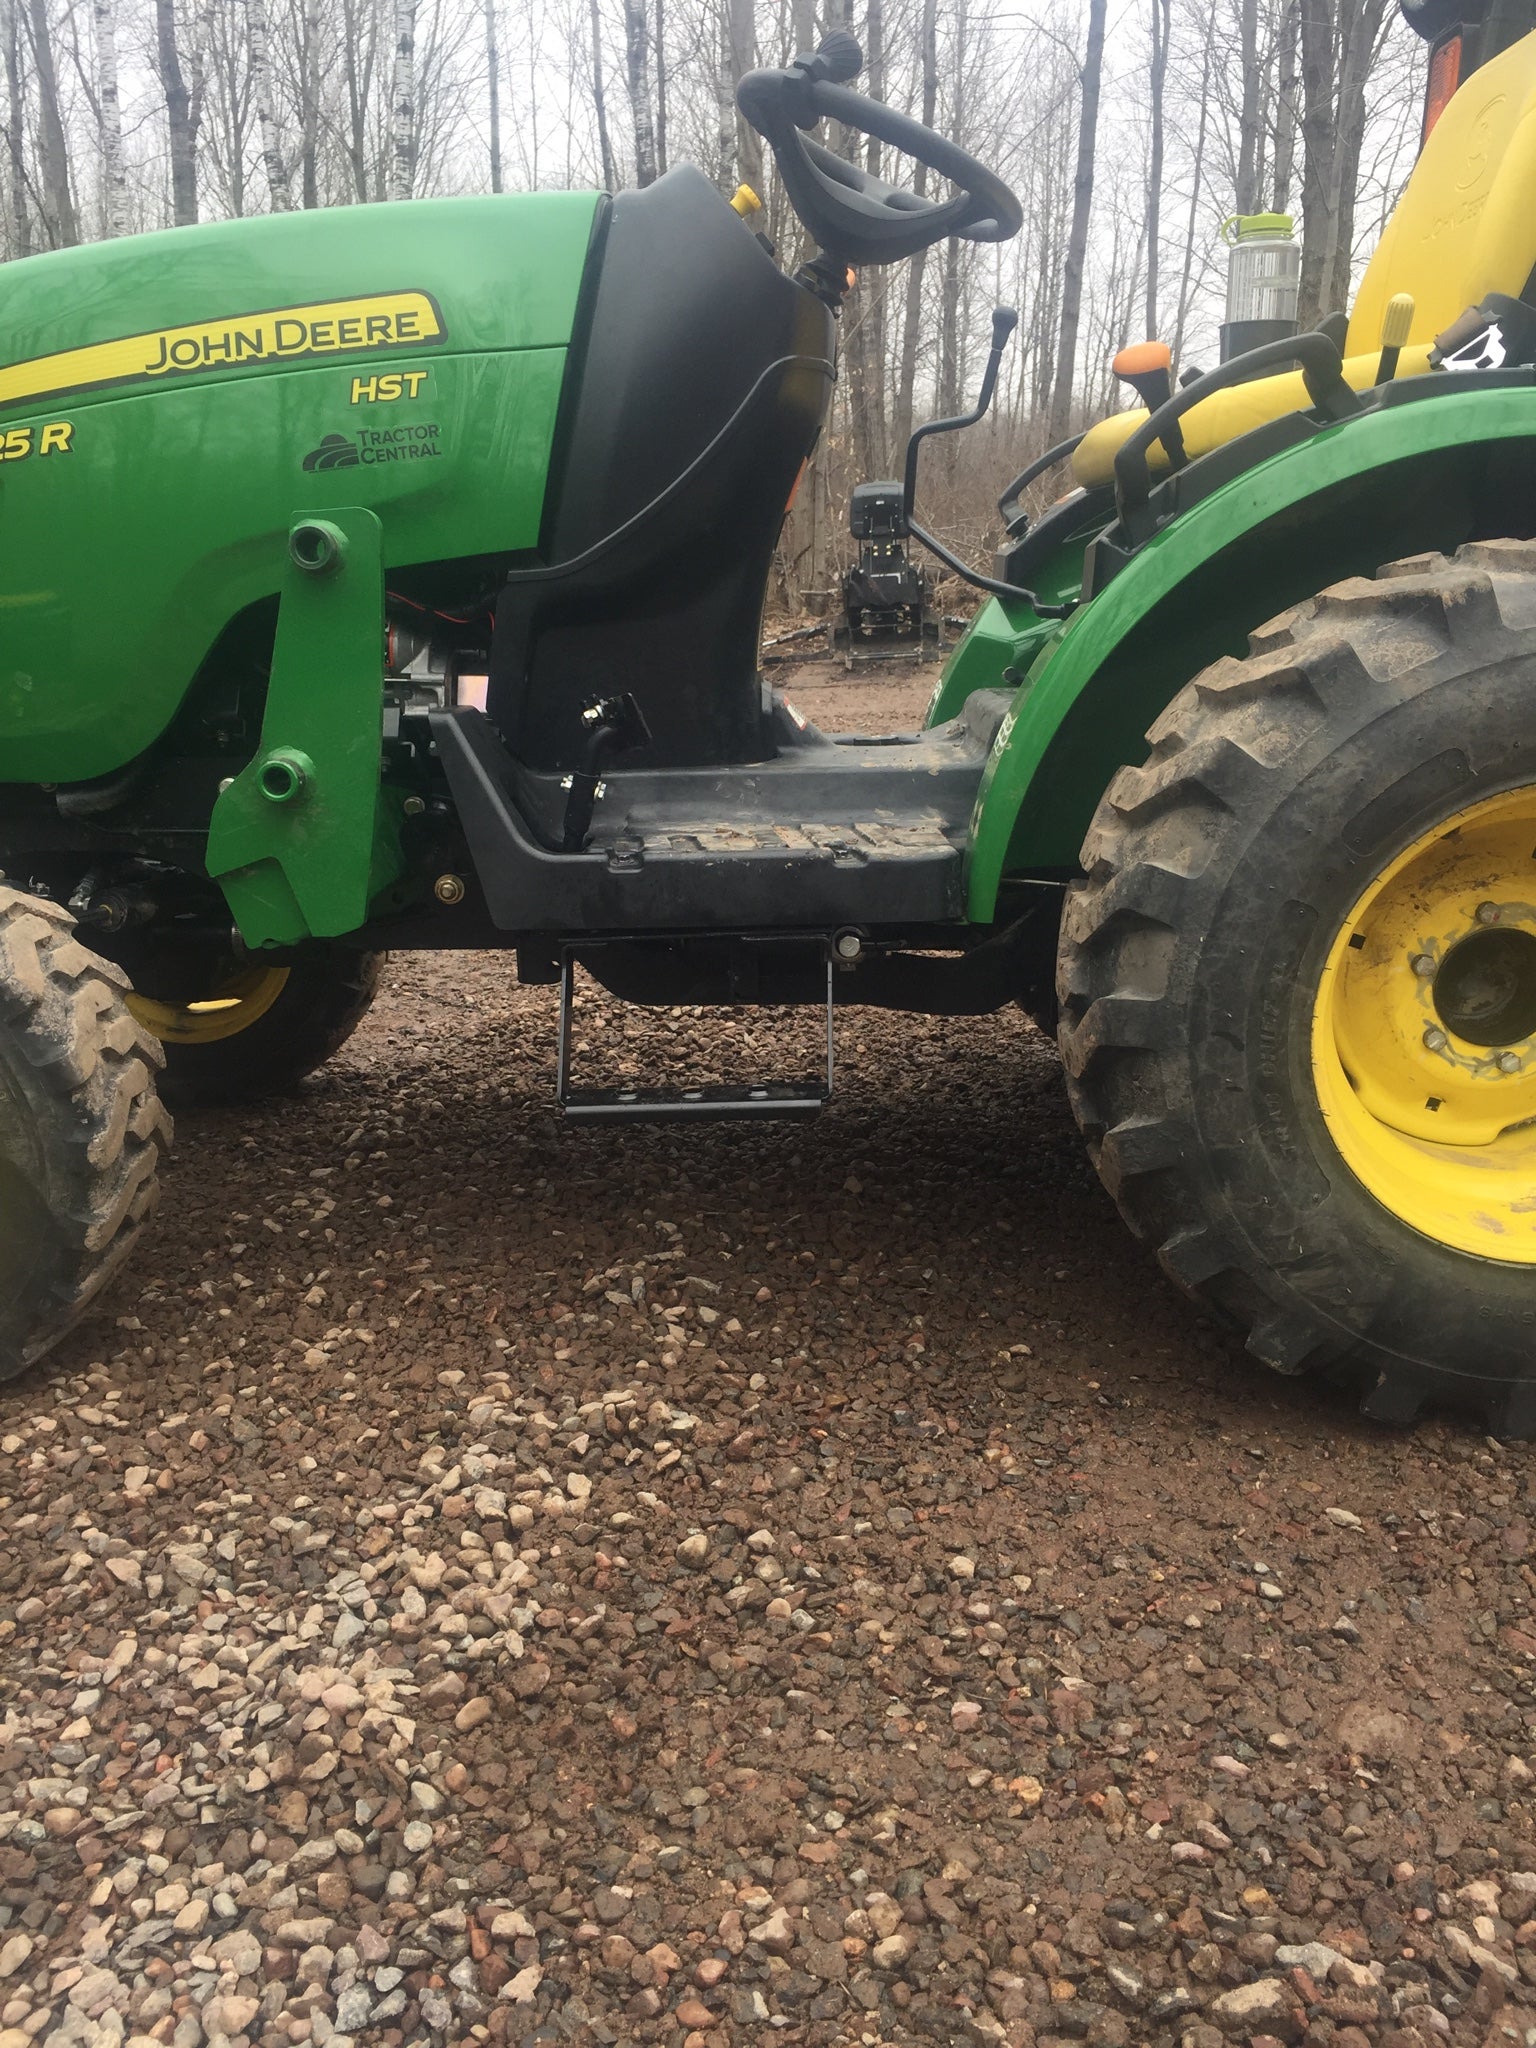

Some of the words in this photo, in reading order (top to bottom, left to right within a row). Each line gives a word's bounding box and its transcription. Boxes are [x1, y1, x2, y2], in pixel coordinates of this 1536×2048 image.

[145, 328, 263, 371] JOHN
[275, 311, 420, 357] DEERE
[350, 370, 428, 405] HST
[0, 427, 33, 462] 5
[40, 421, 73, 456] R
[356, 424, 440, 446] TRACTOR
[360, 442, 441, 465] CENTRAL
